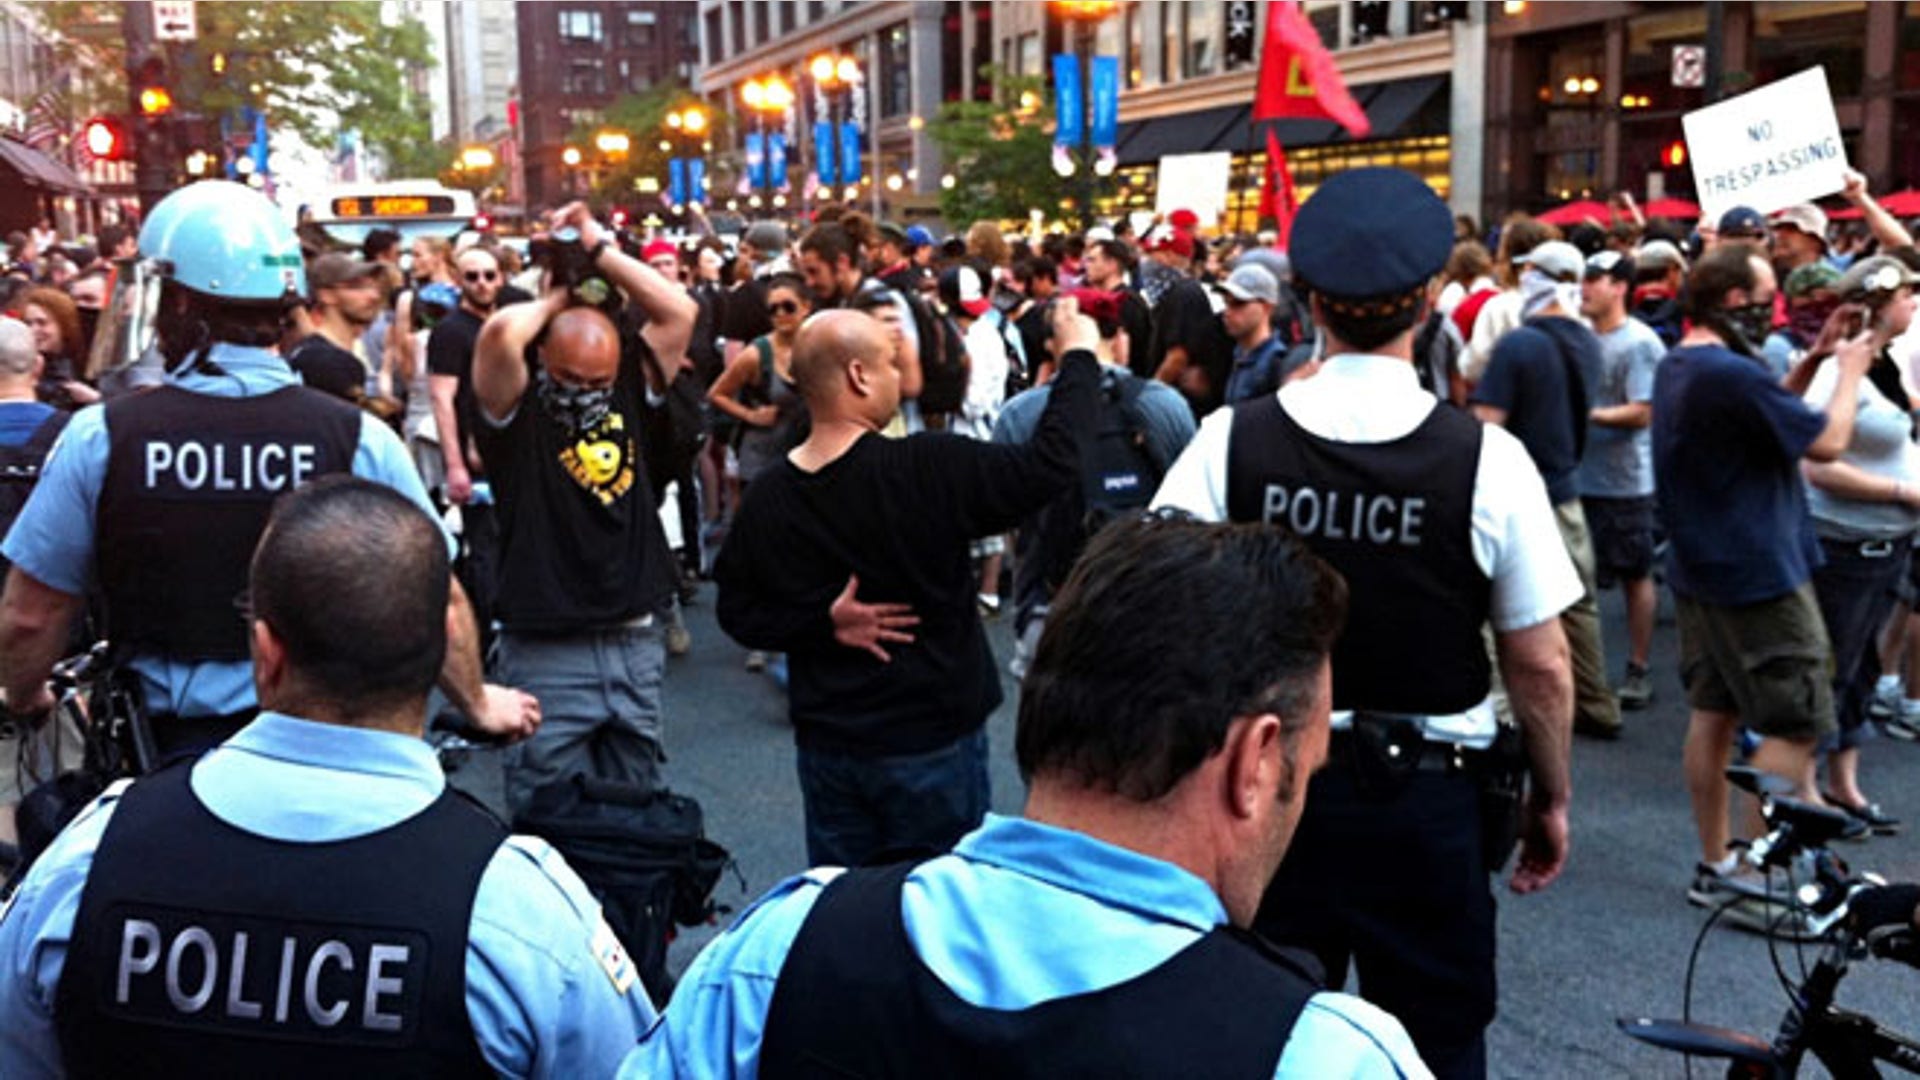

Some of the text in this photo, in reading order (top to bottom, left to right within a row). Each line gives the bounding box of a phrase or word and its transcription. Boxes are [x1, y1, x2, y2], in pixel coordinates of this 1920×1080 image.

[1747, 119, 1773, 142] NO
[1703, 136, 1837, 196] TRESPASSING
[146, 441, 315, 491] POLICE
[1262, 484, 1426, 545] POLICE
[116, 918, 409, 1031] POLICE
